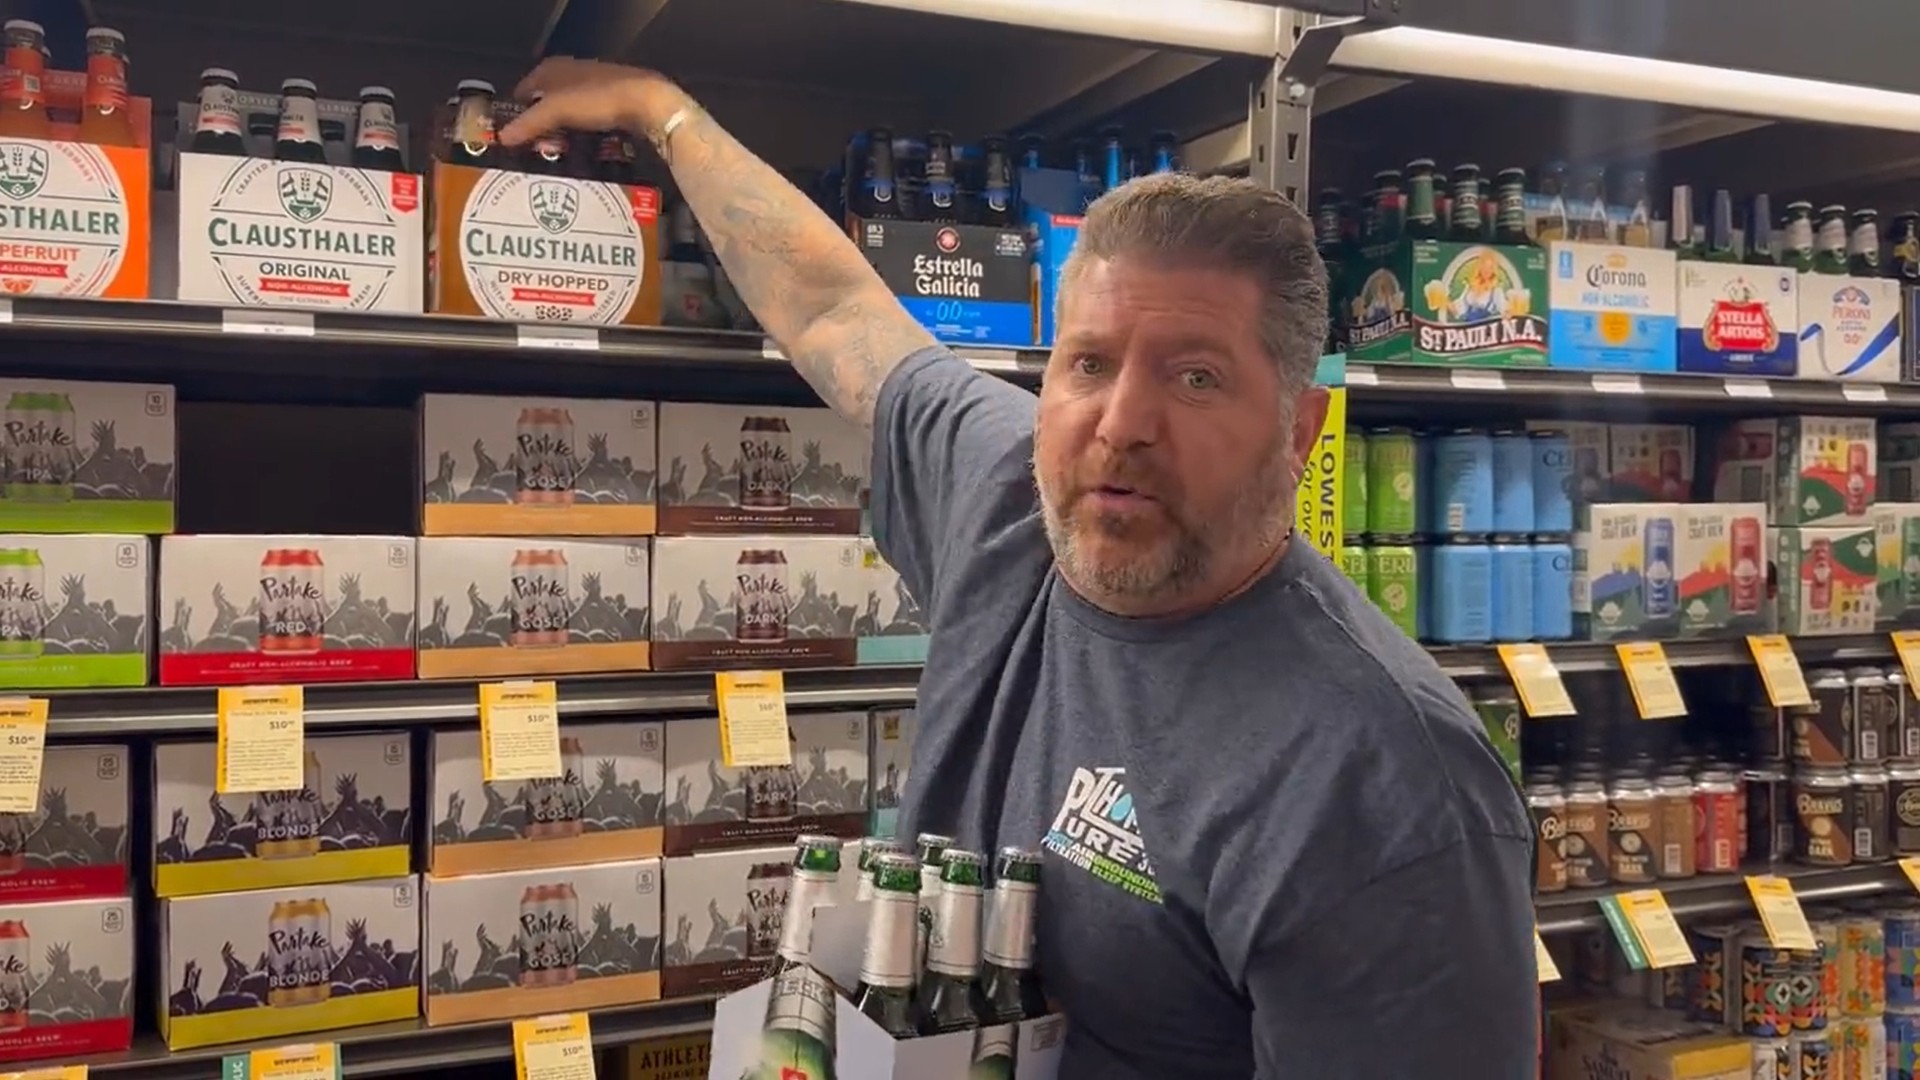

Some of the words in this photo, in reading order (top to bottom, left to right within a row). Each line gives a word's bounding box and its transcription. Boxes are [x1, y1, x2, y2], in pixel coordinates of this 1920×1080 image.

[235, 164, 269, 195] CRAFTED
[337, 168, 373, 207] GERMANY
[208, 217, 396, 257] CLAUSTHALER
[466, 228, 637, 267] CLAUSTHALER
[259, 261, 351, 281] ORIGINAL
[912, 253, 984, 278] Estrella
[498, 270, 533, 284] DRY
[538, 274, 610, 291] HOPPED
[1586, 263, 1647, 289] Corona
[915, 274, 981, 298] Galicia
[1718, 311, 1763, 325] STELLA
[1832, 306, 1871, 320] PERONI
[1444, 323, 1496, 350] PAULI
[1501, 318, 1543, 343] N.A.
[1718, 325, 1765, 339] ARTOIS
[5, 420, 74, 447] Partake
[517, 432, 573, 457] Partake
[740, 440, 790, 462] Partake
[26, 469, 52, 481] IPA
[525, 474, 564, 488] GOSE
[749, 479, 782, 492] DARK
[261, 575, 321, 602] Partake
[511, 575, 568, 600] Partake
[737, 574, 787, 596] Partake
[520, 616, 560, 629] GOSE
[745, 612, 779, 625] DARK
[275, 621, 307, 634] RED
[230, 661, 256, 669] CRAFT
[269, 721, 295, 730] $10
[527, 714, 550, 723] $10
[8, 735, 36, 745] $10
[754, 792, 788, 804] DARK
[534, 807, 576, 821] GOSE
[258, 822, 320, 840] BLONDE
[1040, 836, 1093, 872] FILTRATION
[32, 878, 56, 886] BREW
[519, 911, 577, 937] Partake
[269, 928, 331, 954] Partake
[528, 955, 571, 969] GOSE
[269, 971, 330, 987] BLONDE
[36, 1034, 61, 1042] BREW
[562, 1046, 583, 1056] $10
